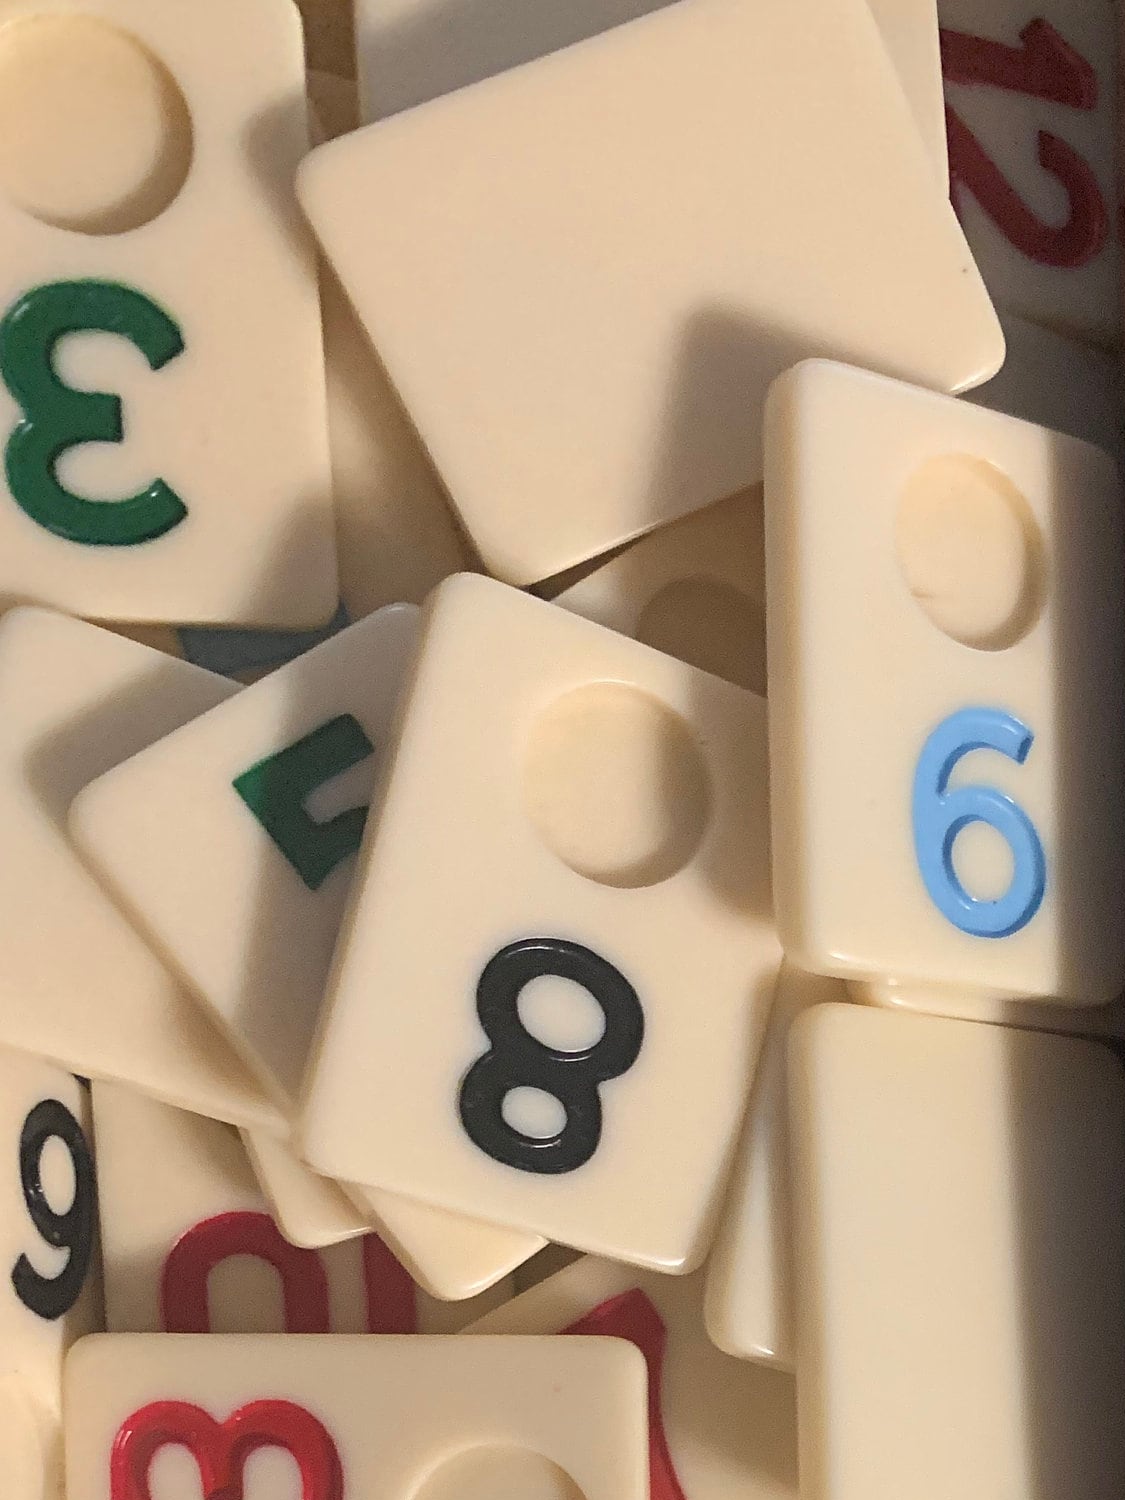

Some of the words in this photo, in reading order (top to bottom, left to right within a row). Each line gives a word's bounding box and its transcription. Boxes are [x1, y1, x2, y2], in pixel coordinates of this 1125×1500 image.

[0, 278, 189, 547] 3
[459, 937, 645, 1175] 8
[11, 1098, 98, 1321] 9
